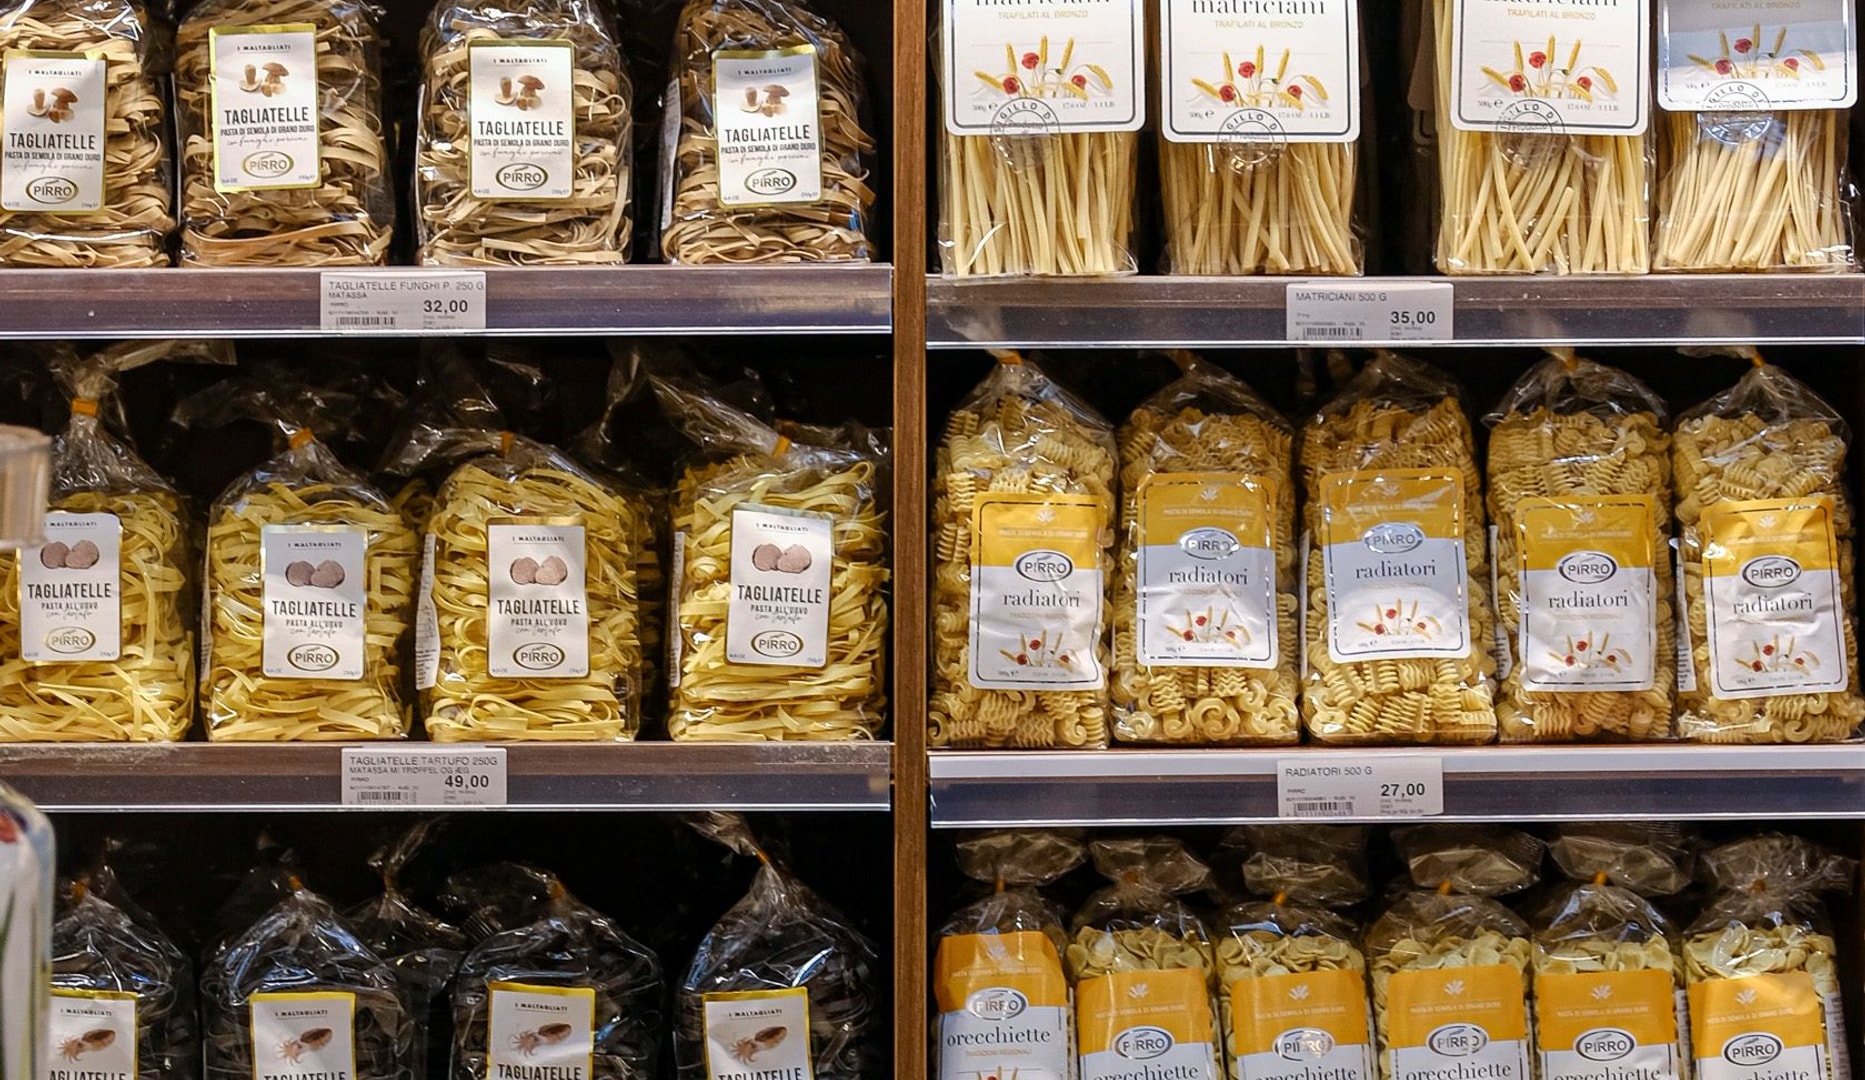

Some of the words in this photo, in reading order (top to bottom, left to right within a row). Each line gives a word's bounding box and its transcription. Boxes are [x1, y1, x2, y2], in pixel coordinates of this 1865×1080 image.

[224, 106, 309, 125] TAGLIATELLE
[220, 127, 239, 137] PASTA
[239, 127, 246, 136] DI
[246, 126, 270, 136] SEMOLA
[270, 126, 277, 135] DI
[278, 125, 299, 134] GRANO
[299, 124, 315, 133] DURO
[478, 120, 564, 136] TAGLIATELLE
[724, 124, 810, 143] TAGLIATELLE
[9, 132, 96, 150] TAGLIATELLE
[473, 139, 492, 147] PASTA
[493, 139, 499, 147] DI
[500, 139, 524, 147] SEMOLA
[525, 139, 532, 147] DI
[532, 139, 553, 147] GRANO
[553, 139, 570, 147] DURO
[721, 146, 739, 154] PASTA
[740, 145, 747, 153] DI
[748, 144, 771, 153] SEMOLA
[772, 143, 779, 152] DI
[779, 143, 799, 151] GRANO
[800, 142, 816, 150] DURO
[4, 151, 23, 160] PASTA
[24, 151, 31, 160] DI
[31, 152, 55, 161] SEMOLA
[56, 152, 63, 161] DI
[63, 152, 84, 161] GRANO
[84, 152, 101, 161] DURO
[249, 156, 287, 171] PIRRO
[502, 169, 542, 183] PIRRO
[751, 174, 791, 188] PIRRO
[33, 182, 72, 197] PIRRO
[328, 281, 397, 291] TAGLIATELLE
[399, 281, 440, 291] FUNGHI
[455, 281, 474, 291] 250
[475, 281, 485, 291] G
[328, 291, 368, 299] MATASSA
[1295, 292, 1356, 302] MATRICIANI
[1359, 292, 1376, 302] 500
[1378, 292, 1387, 301] G
[422, 299, 468, 315] 32,00
[1390, 311, 1436, 326] 35,00
[1024, 561, 1066, 573] PIRRO
[1355, 559, 1436, 580] radiatori
[1568, 563, 1610, 575] PIRRO
[1751, 567, 1794, 580] PIRRO
[1169, 566, 1248, 585] radiatori
[27, 582, 112, 599] TAGLIATELLE
[737, 584, 822, 604] TAGLIATELLE
[41, 601, 63, 610] PASTA
[1003, 590, 1081, 608] radiatori
[1548, 591, 1628, 609] radiatori
[1732, 592, 1813, 615] radiatori
[271, 600, 357, 617] TAGLIATELLE
[497, 599, 581, 615] TAGLIATELLE
[750, 604, 772, 613] PASTA
[286, 618, 307, 627] PASTA
[510, 618, 532, 626] PASTA
[51, 633, 90, 646] PIRRO
[758, 639, 798, 651] PIRRO
[294, 651, 334, 664] PIRRO
[520, 650, 559, 662] PIRRO
[349, 756, 418, 766] TAGLIATELLE
[421, 756, 470, 766] TARTUFO
[472, 756, 498, 766] 250G
[349, 766, 388, 774] MATASSA
[441, 766, 453, 774] OG
[1285, 767, 1341, 777] RADIATORI
[1343, 767, 1362, 776] 500
[1364, 766, 1373, 775] G
[444, 774, 489, 789] 49,00
[1380, 783, 1426, 798] 27,00
[521, 1003, 568, 1011] MALTAGLIATI
[734, 1009, 782, 1017] MALTAGLIATI
[947, 1025, 1050, 1047] orecchiette
[1123, 1038, 1165, 1052] PRRO
[1584, 1040, 1627, 1054] PIRRO
[1732, 1043, 1775, 1059] PIRRO
[49, 1070, 127, 1080] AGLIATELLE
[497, 1064, 582, 1080] TAGLIATELLE
[1256, 1066, 1357, 1080] cchiette
[1406, 1062, 1511, 1080] orecchiette
